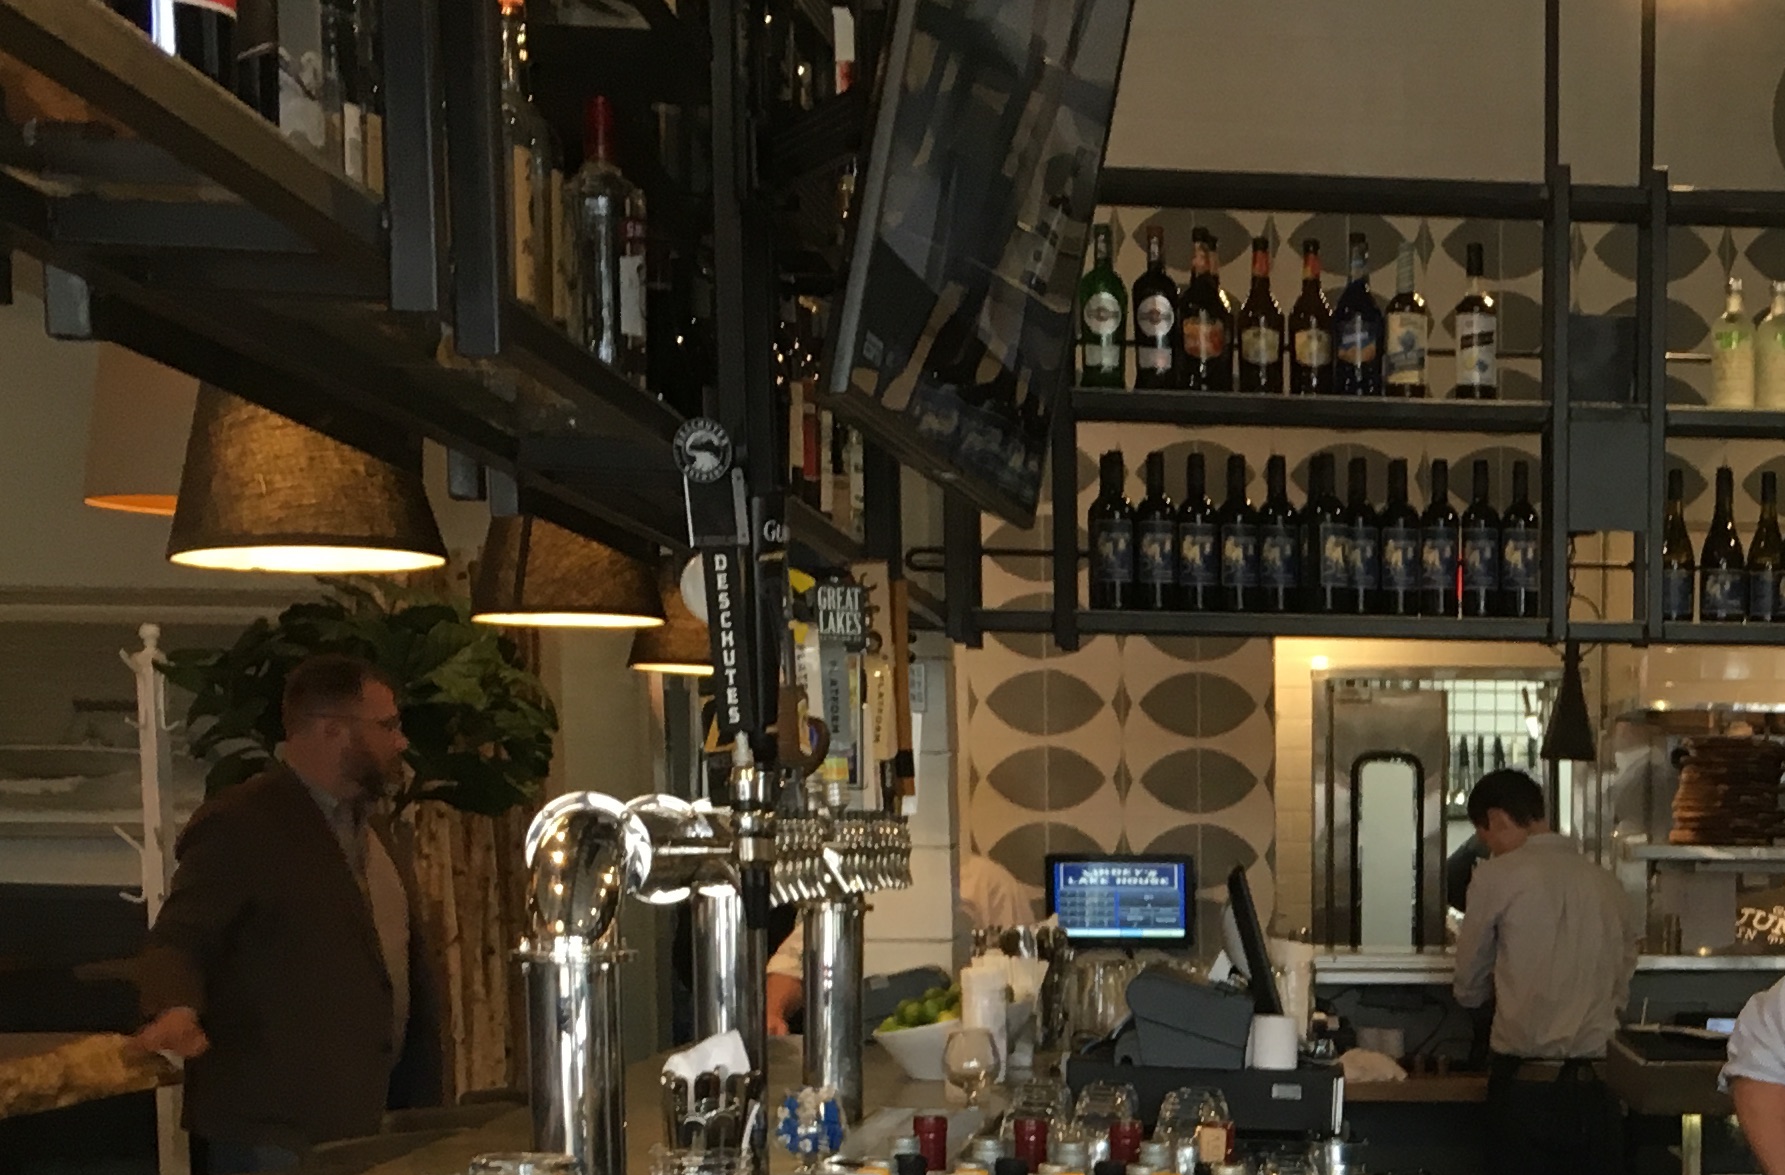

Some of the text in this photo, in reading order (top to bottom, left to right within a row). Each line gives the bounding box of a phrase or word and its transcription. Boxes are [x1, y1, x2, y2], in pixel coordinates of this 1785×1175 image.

[817, 586, 860, 611] GREAT
[819, 610, 861, 635] LAKES
[713, 552, 740, 725] DESCHUTES
